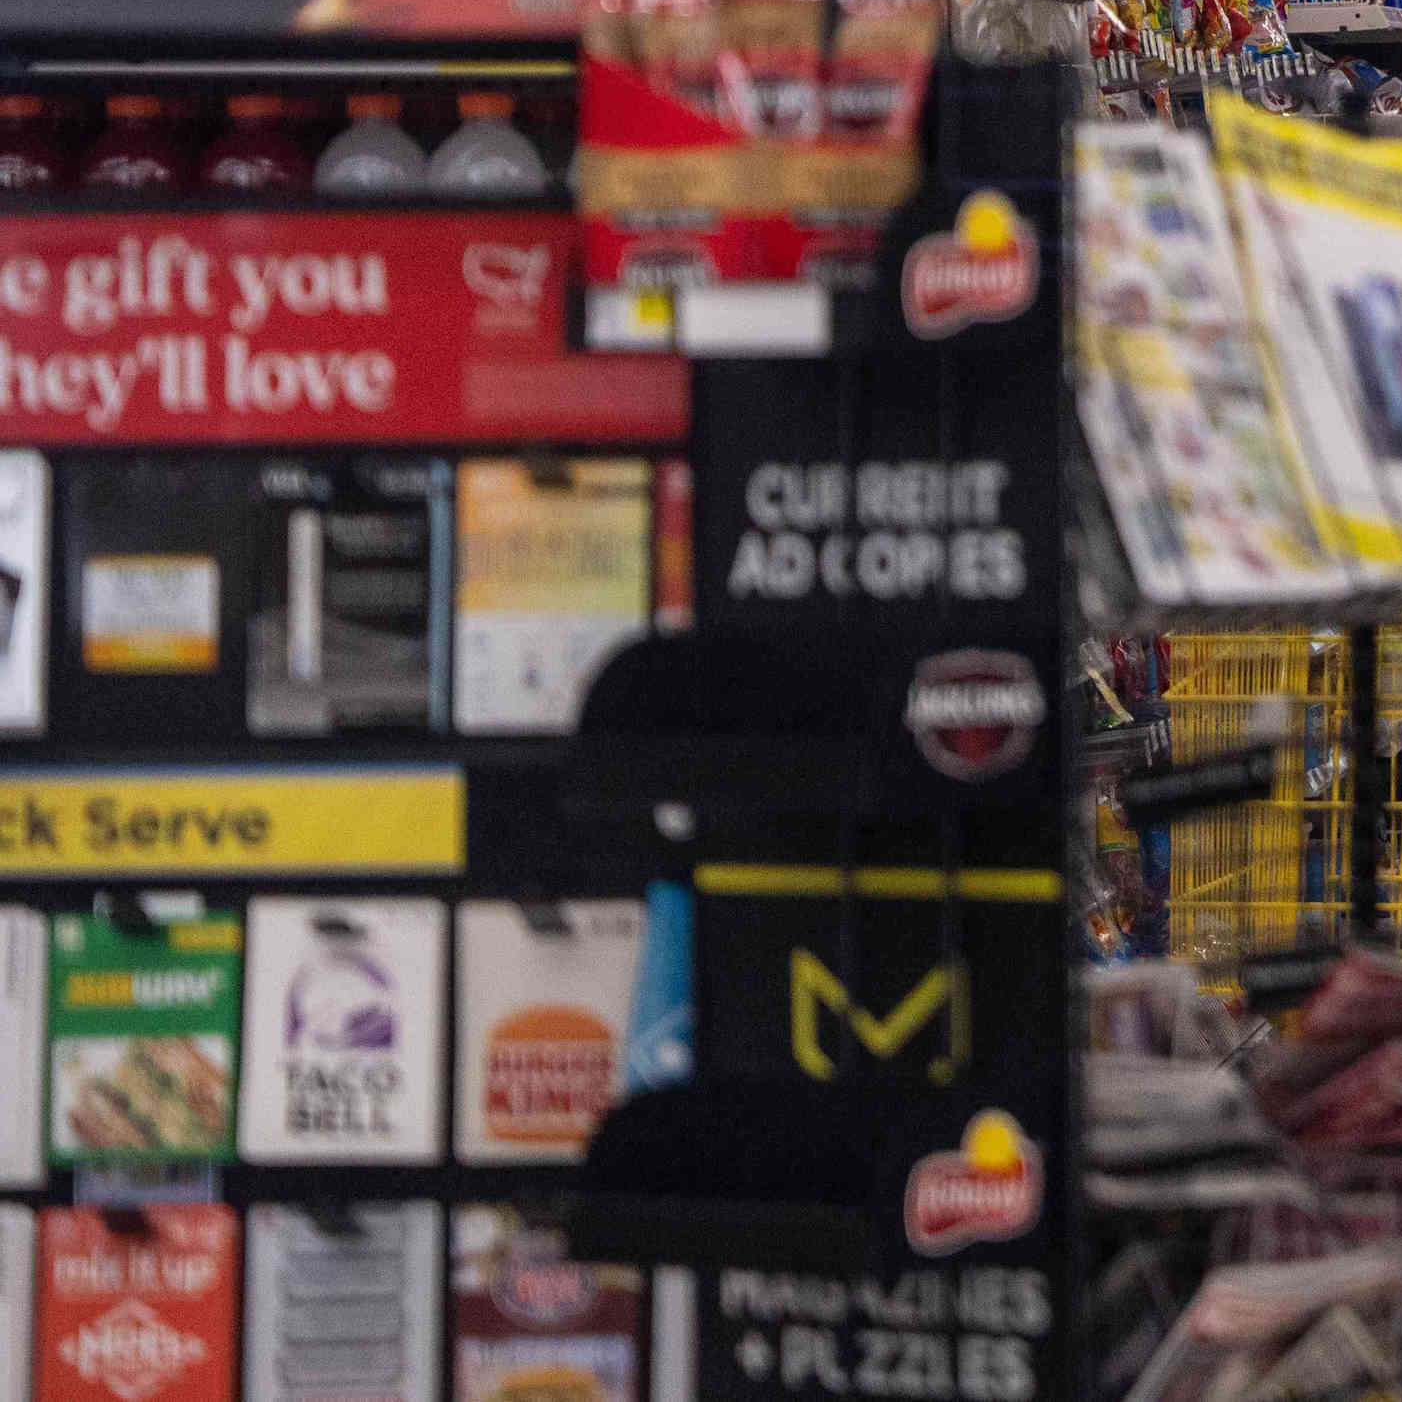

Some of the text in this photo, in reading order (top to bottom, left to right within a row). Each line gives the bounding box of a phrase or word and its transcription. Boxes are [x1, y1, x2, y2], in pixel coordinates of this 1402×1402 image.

[64, 234, 211, 335] gift
[228, 253, 389, 333] you
[0, 333, 395, 432] hey'll love
[726, 530, 817, 598] AD
[81, 797, 273, 849] Serve
[282, 1060, 400, 1096] TACO
[285, 1099, 393, 1135] BELL
